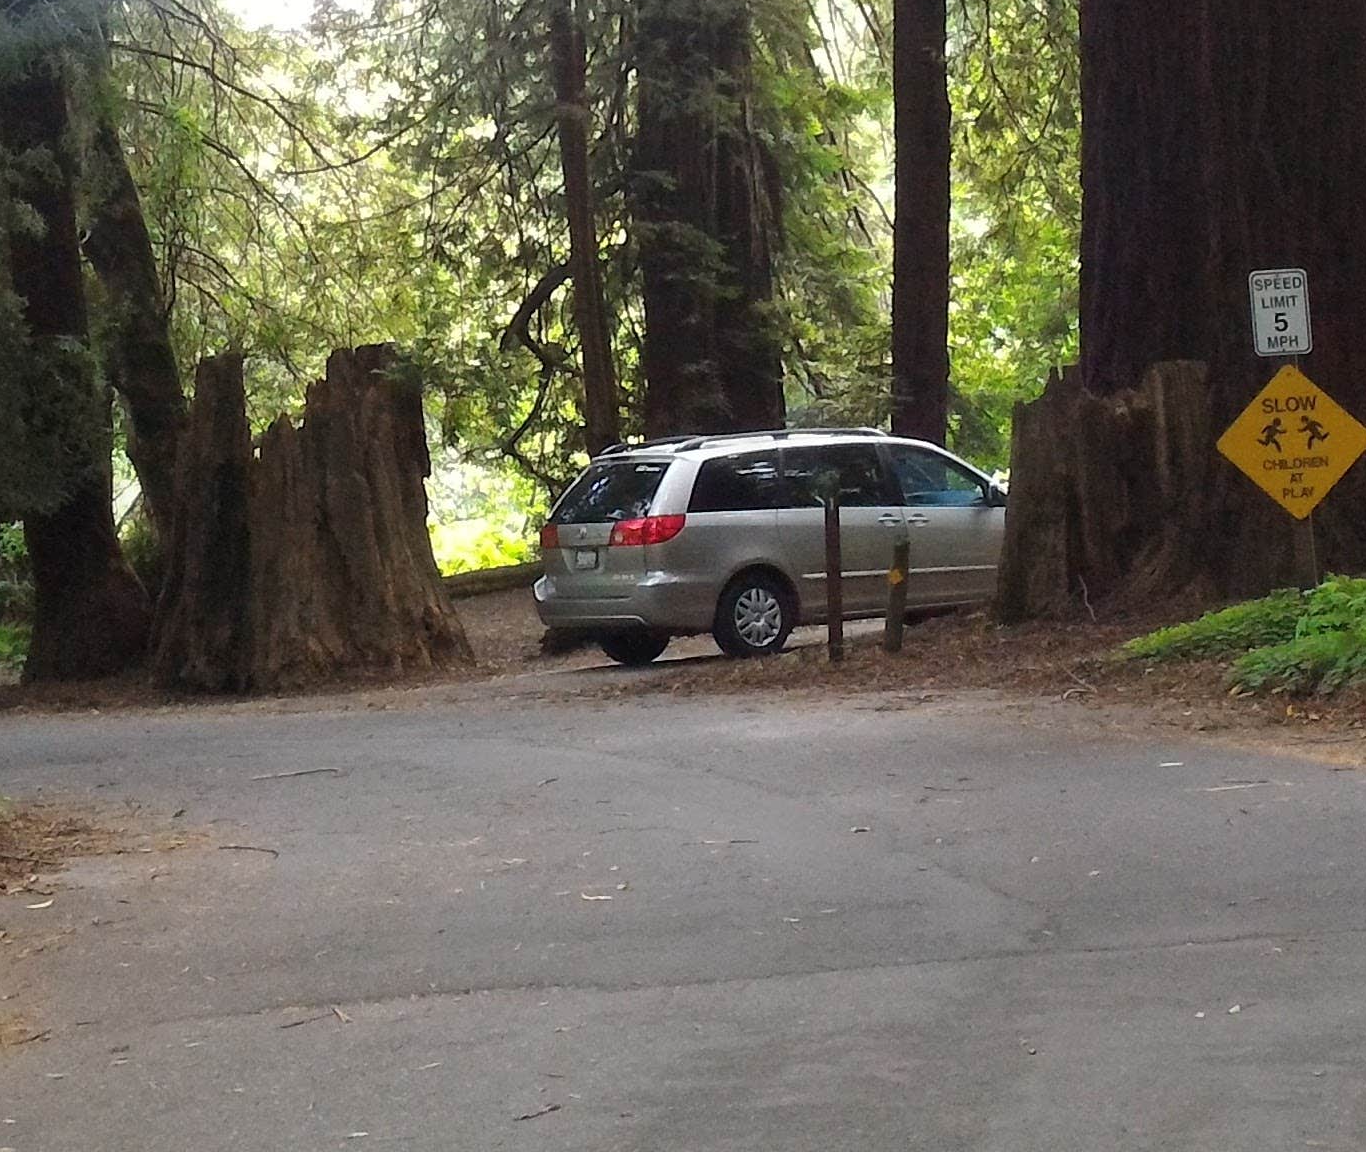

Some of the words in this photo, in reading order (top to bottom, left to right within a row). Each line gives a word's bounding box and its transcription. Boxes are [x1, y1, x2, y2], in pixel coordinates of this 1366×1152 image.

[1254, 277, 1302, 291] SPEED
[1261, 295, 1298, 309] LIMIT
[1274, 312, 1289, 332] 5
[1267, 335, 1299, 348] MPH
[1262, 396, 1317, 414] SLOW
[1263, 456, 1329, 470] CHILDREN
[1290, 473, 1303, 484] AT
[1283, 487, 1314, 498] PLAY
